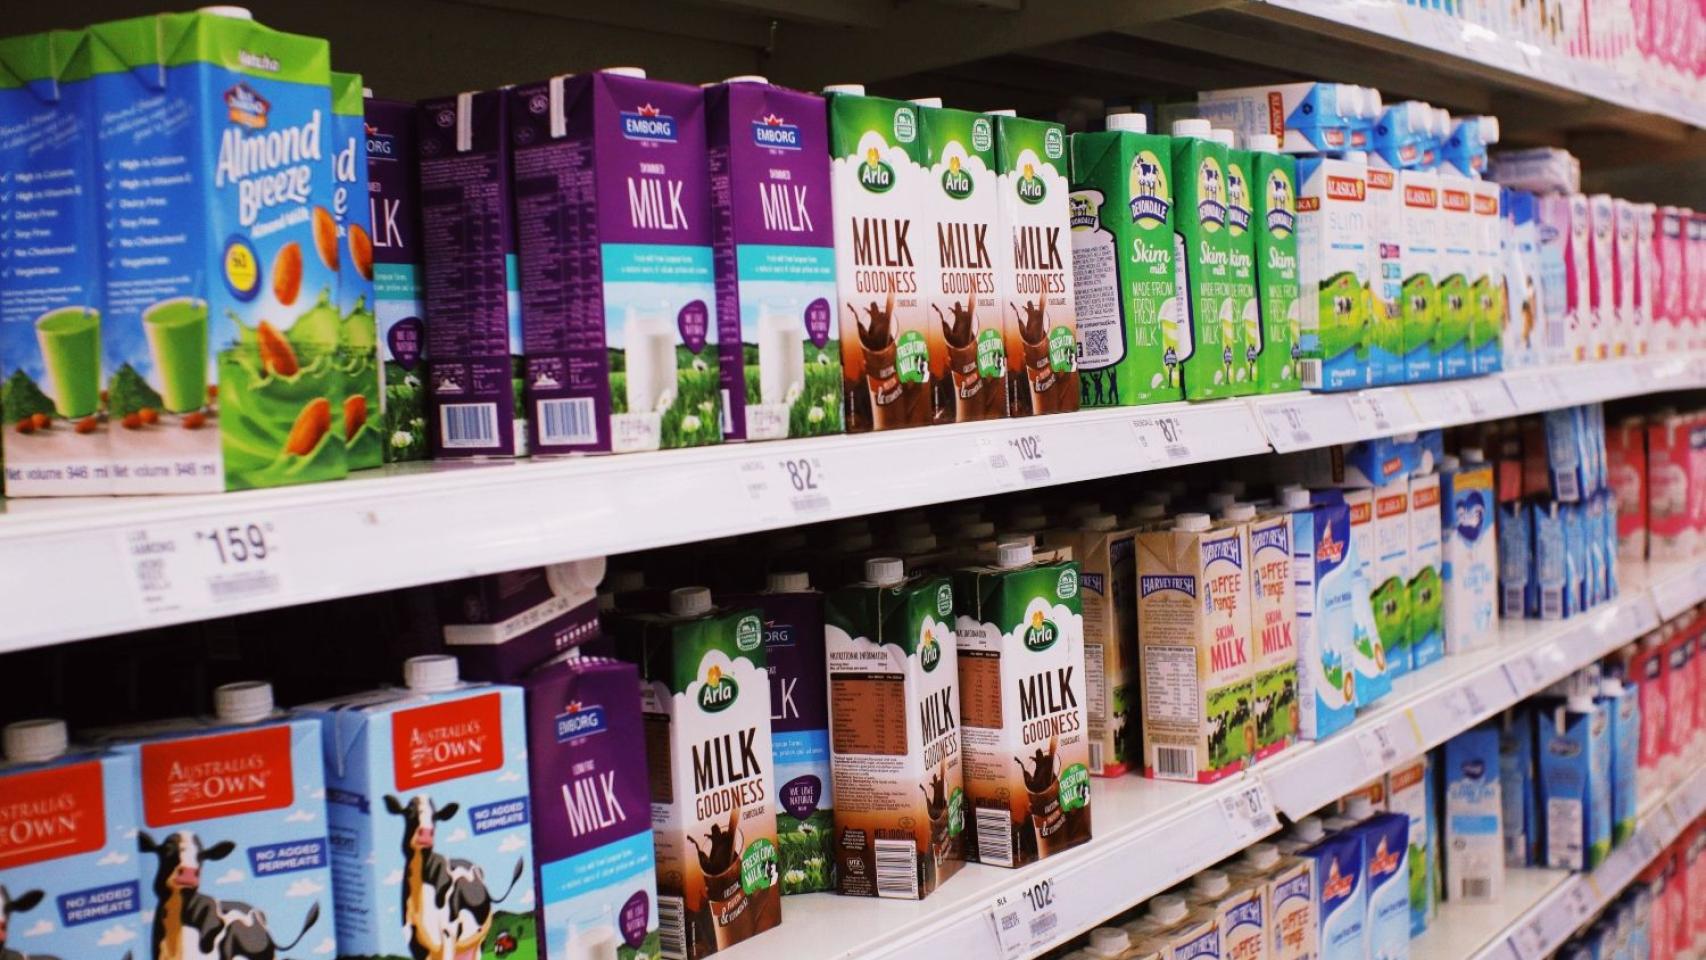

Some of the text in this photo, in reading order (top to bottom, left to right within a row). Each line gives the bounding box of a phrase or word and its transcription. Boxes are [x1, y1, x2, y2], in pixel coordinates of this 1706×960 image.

[626, 119, 671, 136] EMBORG
[757, 127, 795, 144] EMBORG
[216, 109, 321, 187] Almond
[862, 166, 889, 185] Arla
[945, 174, 969, 191] Arla
[239, 164, 311, 227] Breeze
[1020, 181, 1041, 197] Arla
[628, 177, 689, 230] MILK
[760, 182, 813, 232] MILK
[1131, 200, 1167, 219] DEVONDALE
[370, 198, 403, 248] LK
[852, 216, 914, 267] MILK
[937, 222, 992, 269] MILK
[1013, 226, 1063, 270] MILK
[1131, 238, 1171, 263] Skim
[1200, 240, 1228, 265] Skim
[1150, 264, 1168, 275] milk
[1229, 248, 1251, 268] kim
[1268, 247, 1296, 269] Skim
[856, 271, 917, 294] GOODNESS
[942, 273, 994, 294] GOODNESS
[1016, 273, 1066, 293] GOODNESS
[1132, 282, 1173, 296] MADE FROM
[1135, 328, 1158, 347] MILK
[1159, 418, 1178, 442] 87
[1015, 435, 1042, 460] 102
[787, 459, 817, 491] 82
[208, 524, 266, 564] 159
[1028, 627, 1052, 646] Arla
[1261, 622, 1292, 656] MILK
[923, 648, 937, 665] Arla
[1210, 638, 1247, 673] MILK
[703, 684, 732, 706] Arla
[1018, 666, 1077, 722] MILK
[559, 713, 598, 735] EMBORG
[920, 686, 954, 746] MILK
[409, 720, 481, 747] AUSTRALIA'S
[1022, 711, 1080, 746] GOODNESS
[434, 738, 482, 762] OWN
[692, 728, 761, 795] MILK
[923, 731, 958, 771] GOODNESS
[169, 755, 264, 781] AUSTRALIA'S
[203, 774, 266, 798] OWN
[0, 793, 76, 821] STRALIA'S
[474, 802, 524, 820] NO ADDED
[562, 770, 626, 837] MILK
[696, 778, 764, 821] GOODNESS
[10, 815, 77, 844] OWN
[476, 812, 524, 831] PERMEATE
[255, 843, 320, 861] NO ADDED
[257, 854, 320, 872] PERMEATE
[741, 852, 759, 871] FRESH
[744, 865, 764, 887] MILK
[65, 887, 132, 910] NO ADDED
[1027, 880, 1052, 912] 102
[67, 900, 132, 922] PERMEATE
